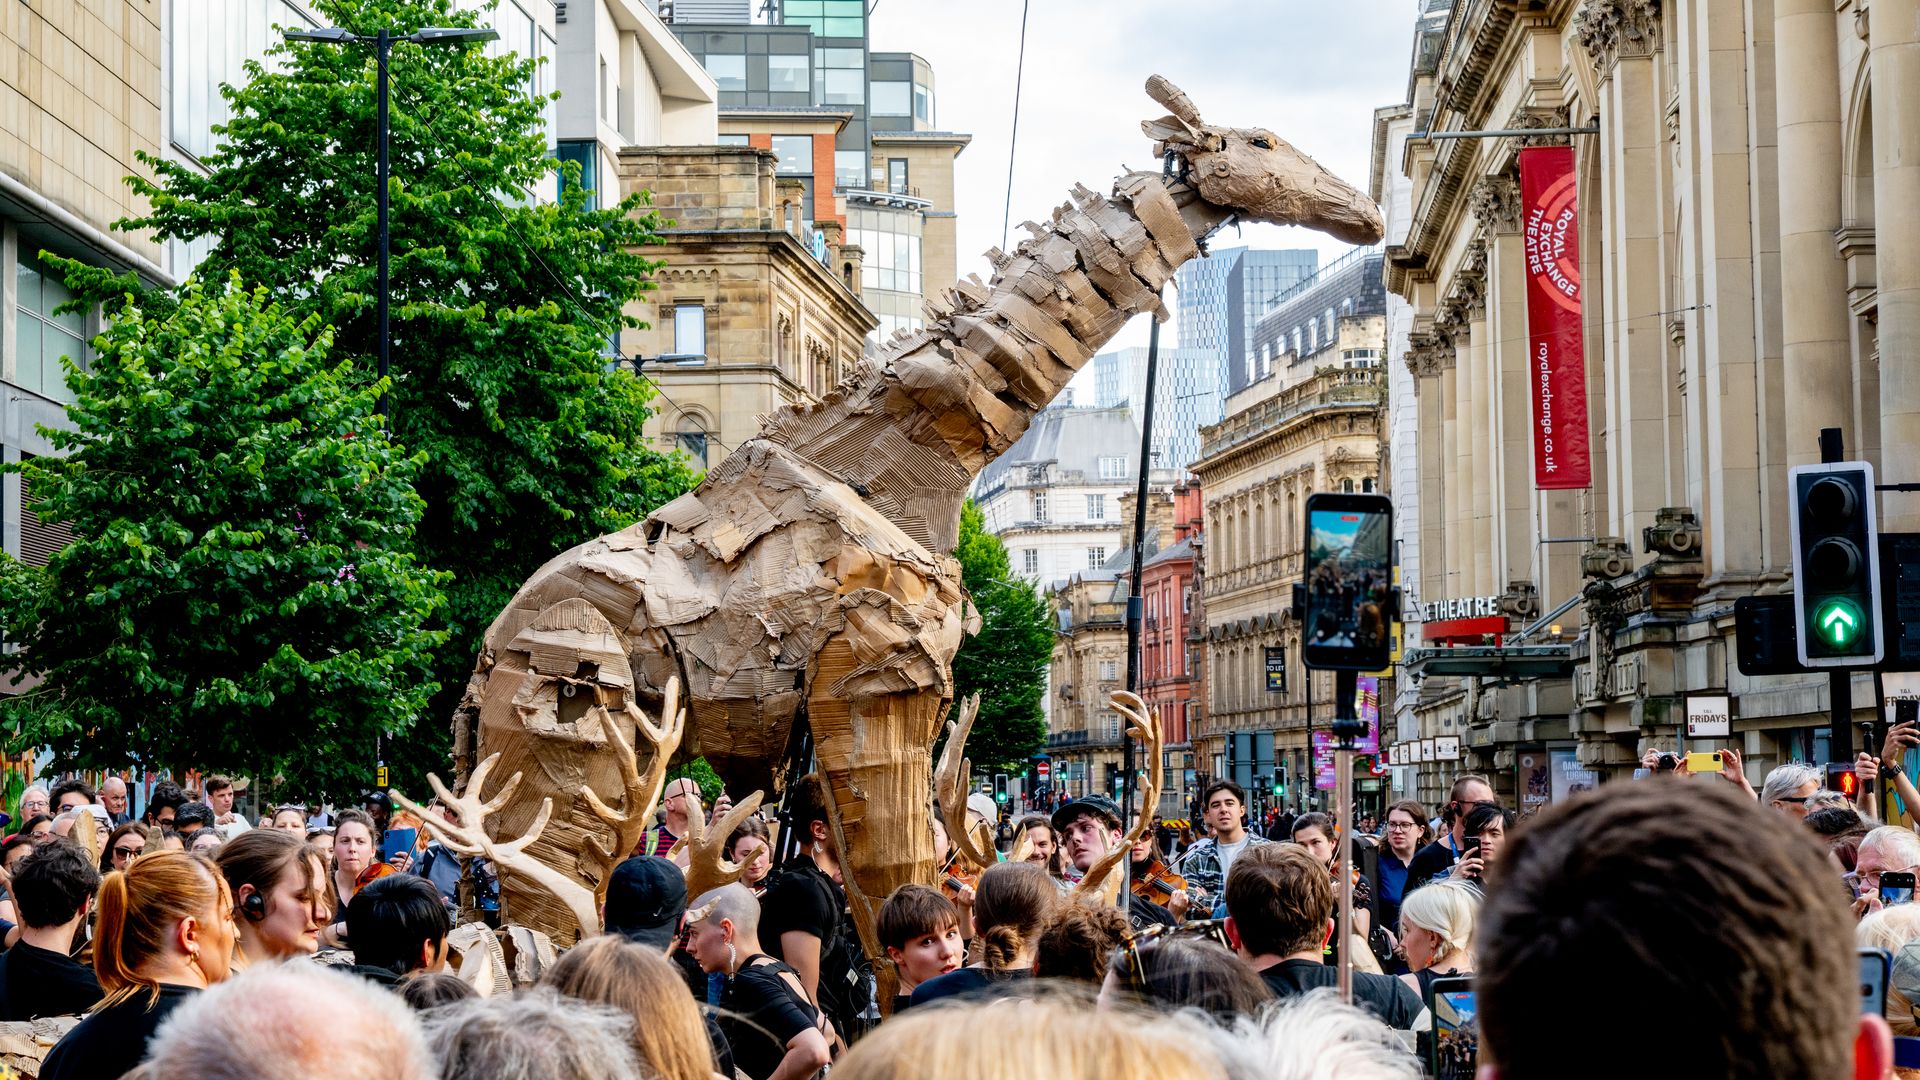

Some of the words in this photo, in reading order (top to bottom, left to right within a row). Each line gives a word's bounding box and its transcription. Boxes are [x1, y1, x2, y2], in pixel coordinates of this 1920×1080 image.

[1527, 209, 1544, 275] THEATRE
[1540, 222, 1577, 297] EXCHANGE
[1553, 209, 1575, 258] ROYAL
[1538, 342, 1558, 473] royalexchange.co.uk
[1433, 596, 1498, 621] THEATRE
